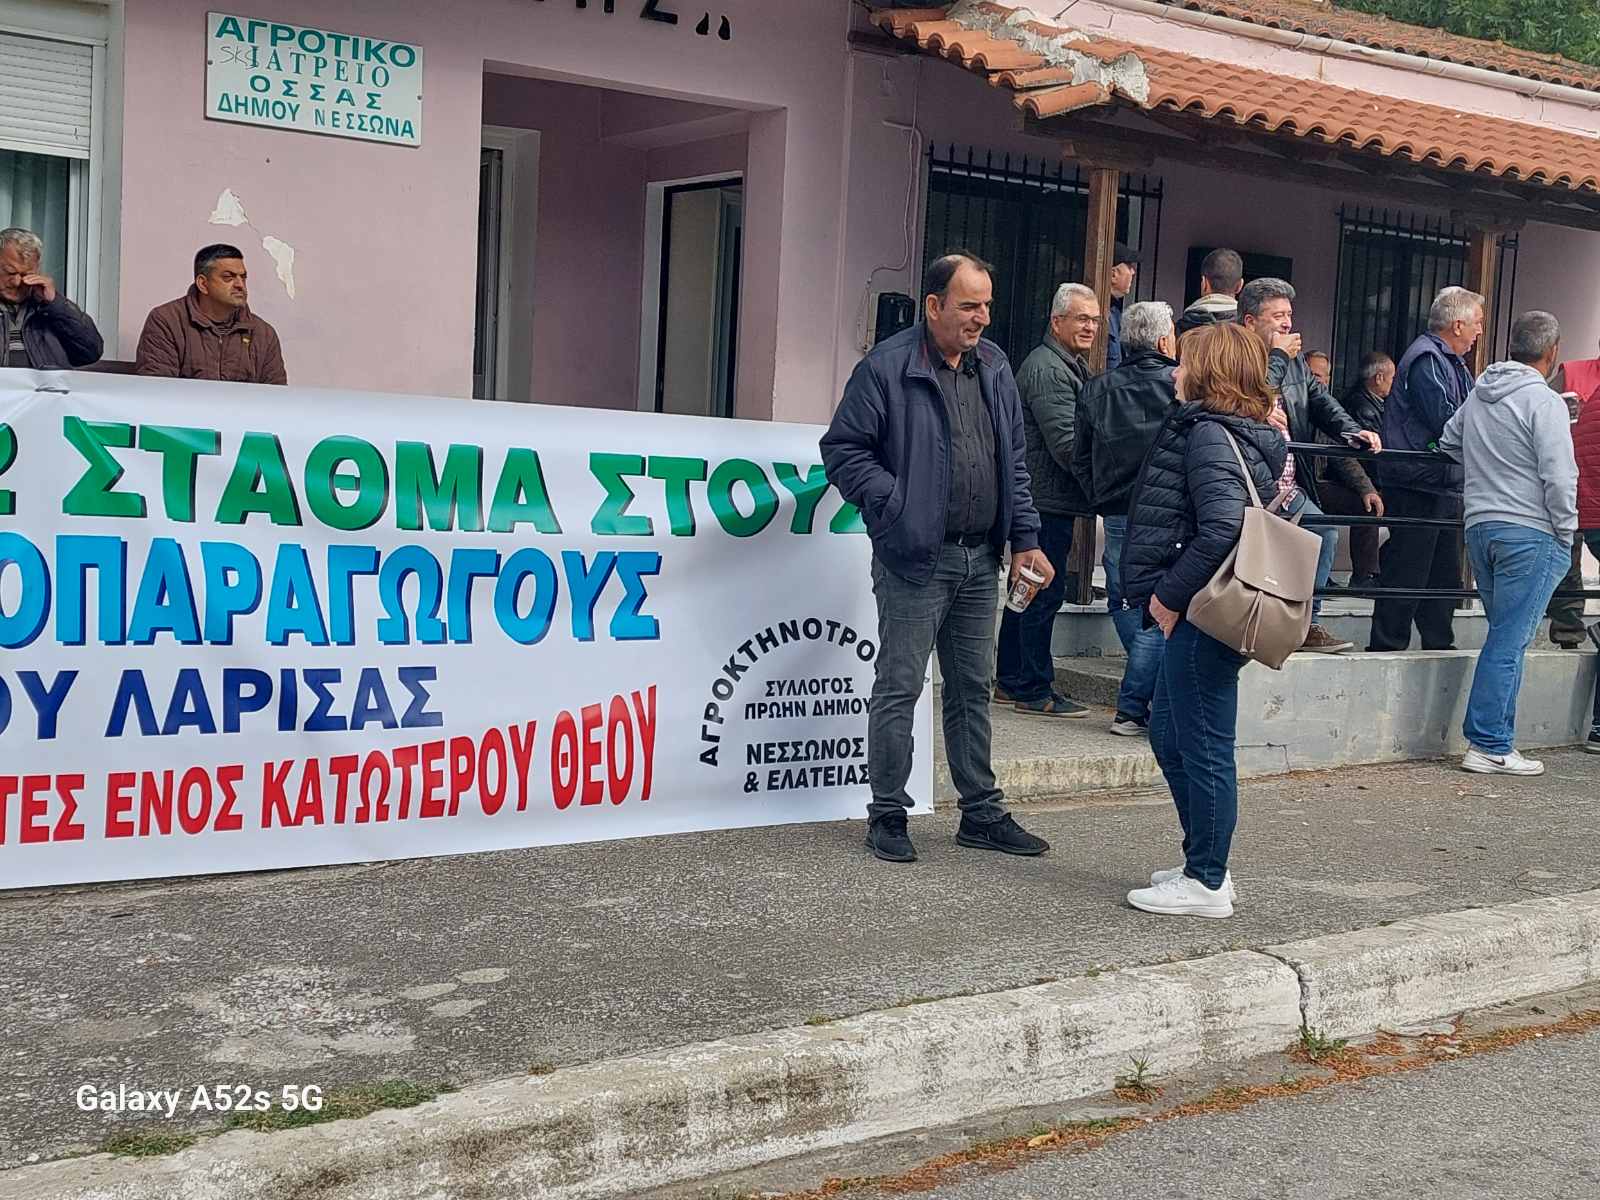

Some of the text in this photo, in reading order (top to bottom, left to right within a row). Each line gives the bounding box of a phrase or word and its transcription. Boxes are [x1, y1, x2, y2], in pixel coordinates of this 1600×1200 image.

[215, 16, 416, 68] ΑΓΡΟΤΙΚΟ
[249, 45, 390, 88] ΙΑΤΡΕΙΟ
[249, 74, 382, 110] ΟΣΣΑΣ
[217, 92, 415, 139] ΔΗΜΟΥ ΝΕΣΣΩΝΑ
[62, 415, 562, 535] ΣΤΑΘΜΑ
[589, 452, 868, 538] ΣΤΟΥ
[0, 666, 444, 740] Υ ΛΑΡΙΣΑΣ
[699, 617, 878, 768] ΑΓΡΟΚΤΗΝΟΤΡΟ
[765, 677, 854, 697] ΣΥΛΛΟΓΟΣ
[744, 701, 806, 720] ΠΡΩΗΝ
[105, 765, 245, 839] ΕΝΟΣ
[261, 720, 537, 829] ΚΑΤΩΤΕΡΟΥ
[550, 684, 657, 811] ΘΕΟΥ
[746, 737, 864, 766] ΝΕΣΣΩΝΟΣ
[743, 765, 870, 793] & ΕΛΑΤΕΙΑΣ
